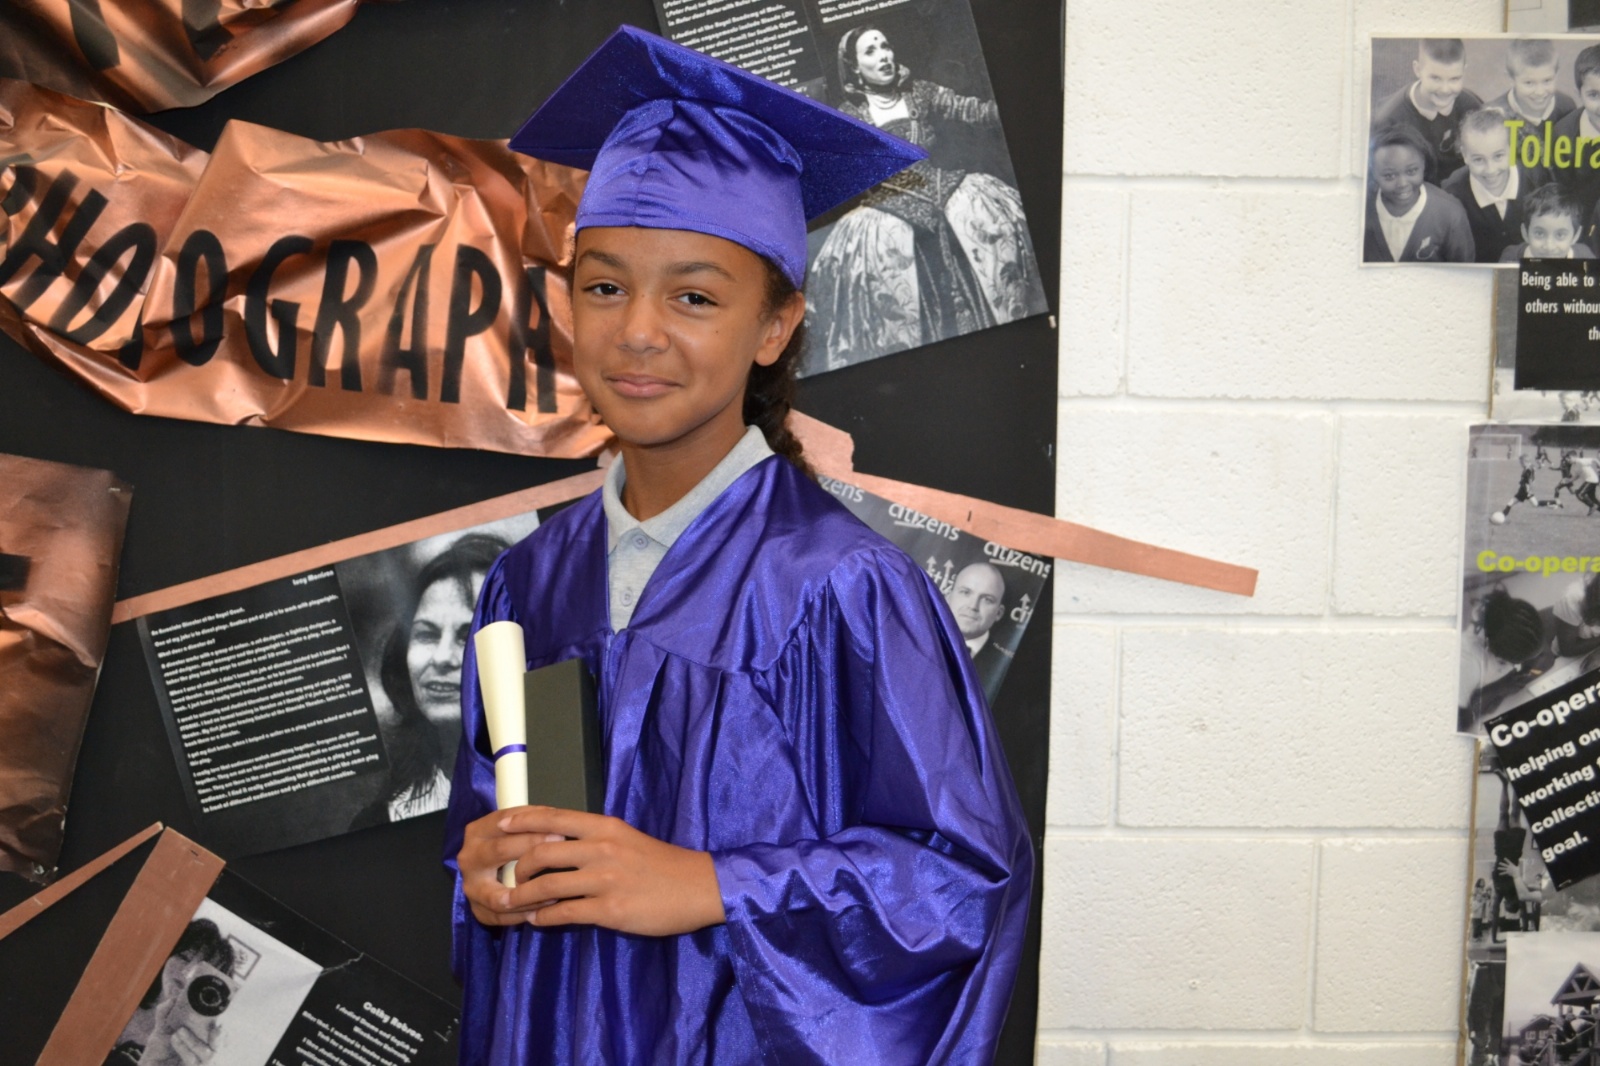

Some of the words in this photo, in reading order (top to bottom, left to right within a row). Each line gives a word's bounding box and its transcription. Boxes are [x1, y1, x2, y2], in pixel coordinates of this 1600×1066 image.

[1522, 271, 1551, 290] Being
[1556, 272, 1578, 287] able
[1583, 275, 1594, 287] to
[1525, 300, 1558, 314] others
[1588, 326, 1600, 340] th
[888, 503, 960, 541] citizens
[1507, 740, 1576, 782] helping
[1519, 764, 1595, 807] working
[1541, 831, 1589, 863] goal.
[363, 1002, 390, 1023] Cathy
